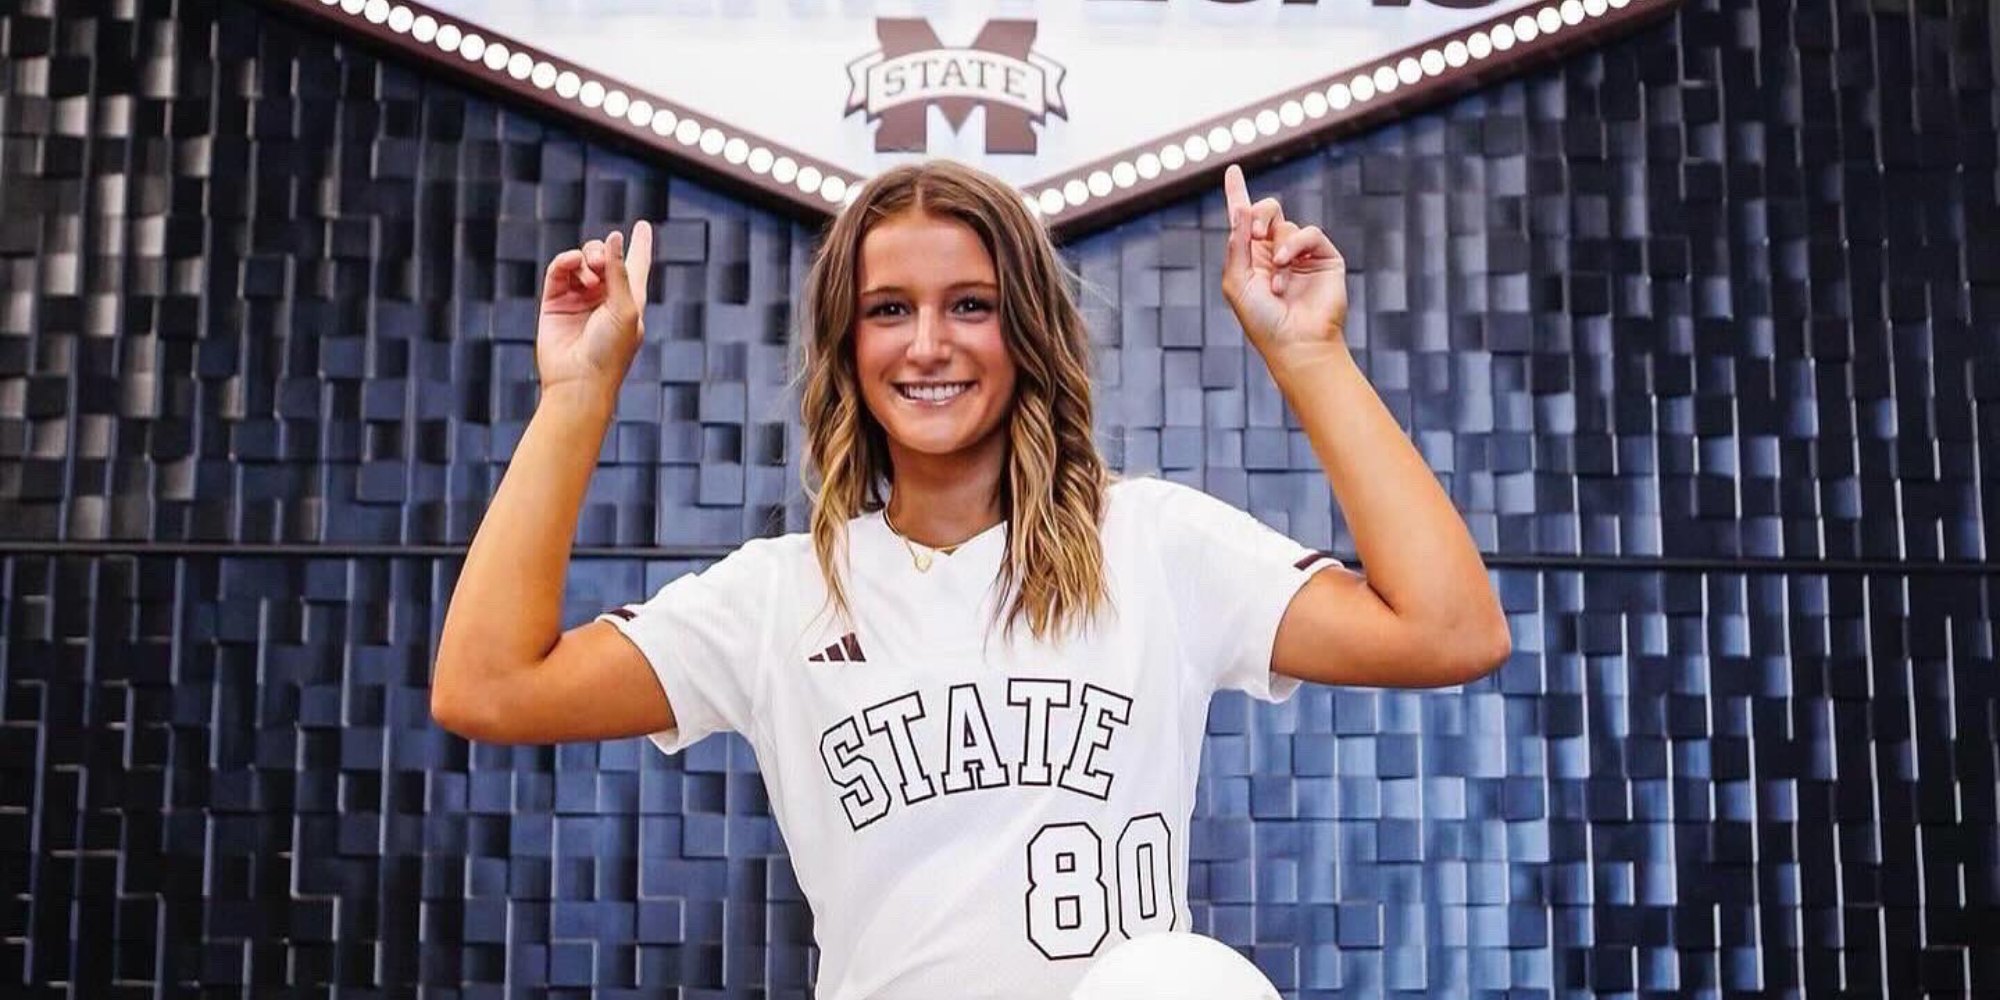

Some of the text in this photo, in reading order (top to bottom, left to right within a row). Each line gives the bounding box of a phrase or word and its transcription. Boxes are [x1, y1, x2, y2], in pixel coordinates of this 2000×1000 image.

[884, 58, 1027, 99] STATE
[819, 678, 1133, 831] STATE
[1025, 812, 1177, 961] 80
